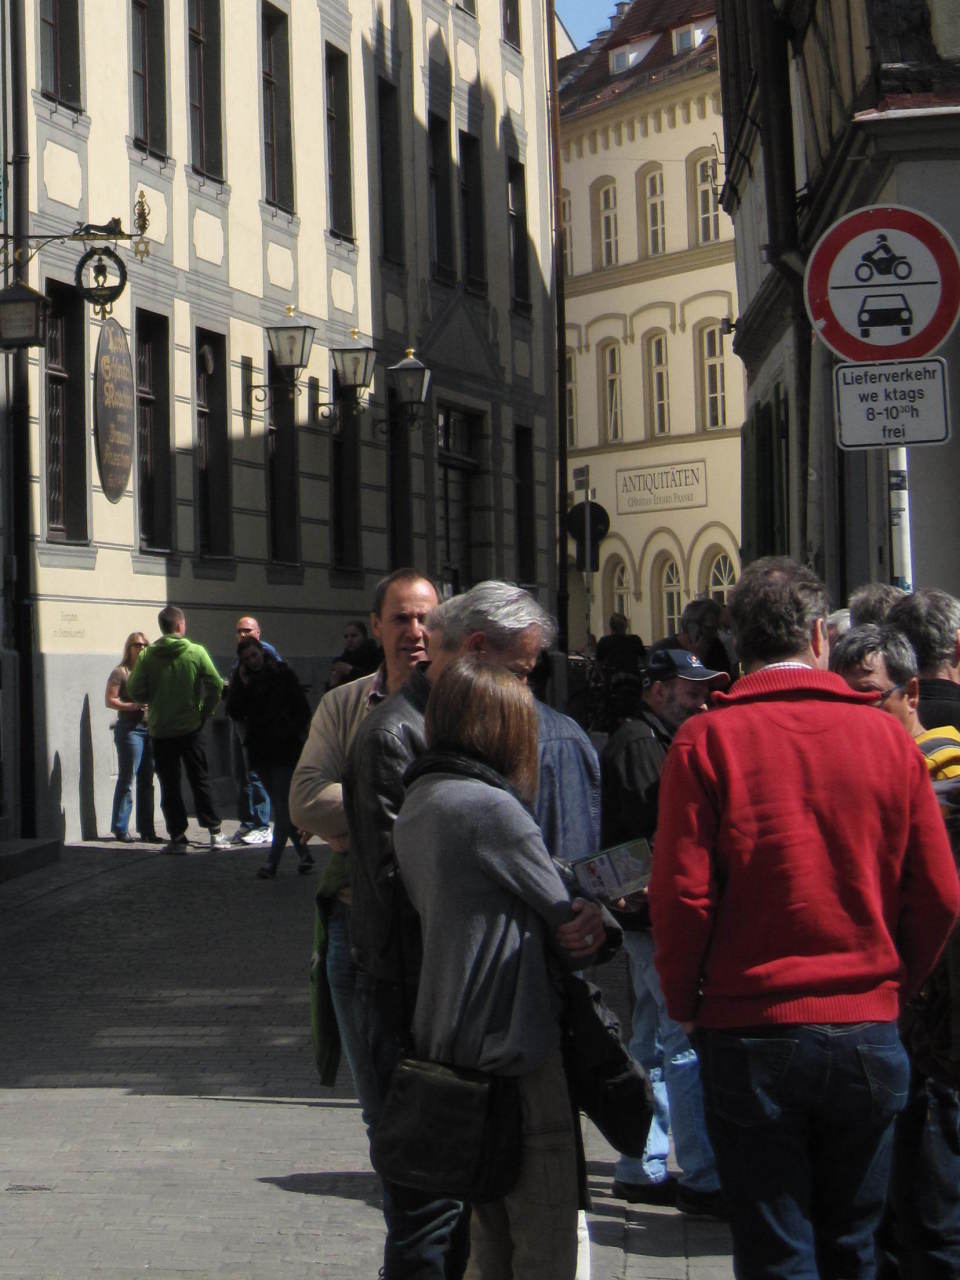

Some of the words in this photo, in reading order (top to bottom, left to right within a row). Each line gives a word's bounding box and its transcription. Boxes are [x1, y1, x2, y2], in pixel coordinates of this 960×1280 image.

[842, 367, 937, 386] Lieferverkehr
[858, 388, 925, 403] wektags
[882, 424, 906, 439] frei
[622, 467, 700, 495] ANTIQUITÄTEN
